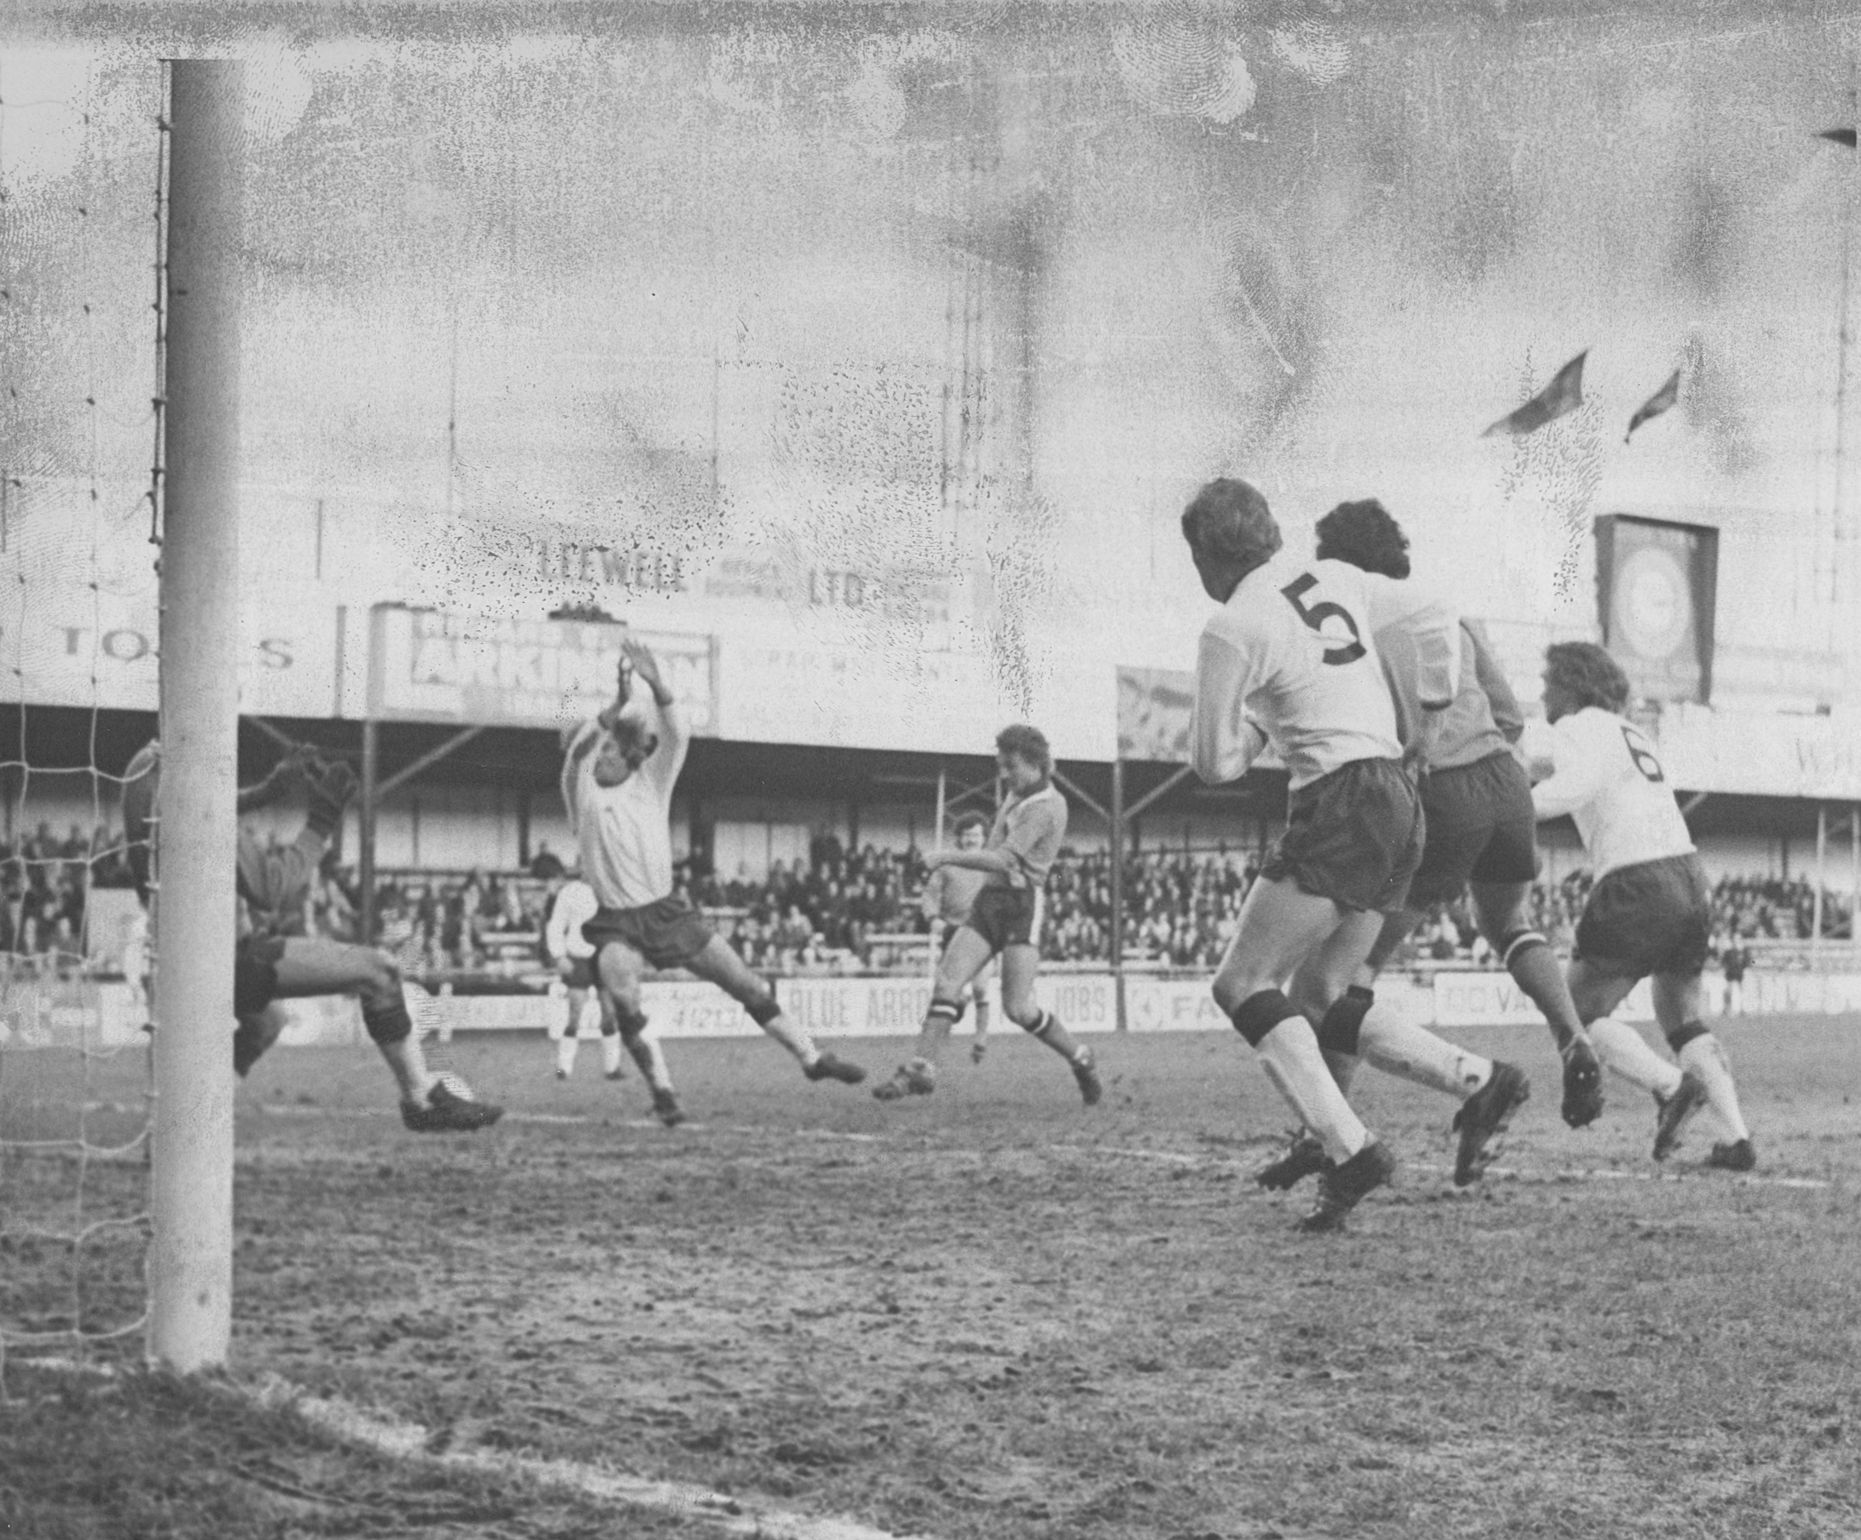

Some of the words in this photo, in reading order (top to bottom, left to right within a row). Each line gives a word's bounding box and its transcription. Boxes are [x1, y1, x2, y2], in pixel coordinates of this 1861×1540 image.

[1281, 572, 1367, 666] 5
[1620, 725, 1664, 782] 6
[866, 985, 931, 1028] ARRO
